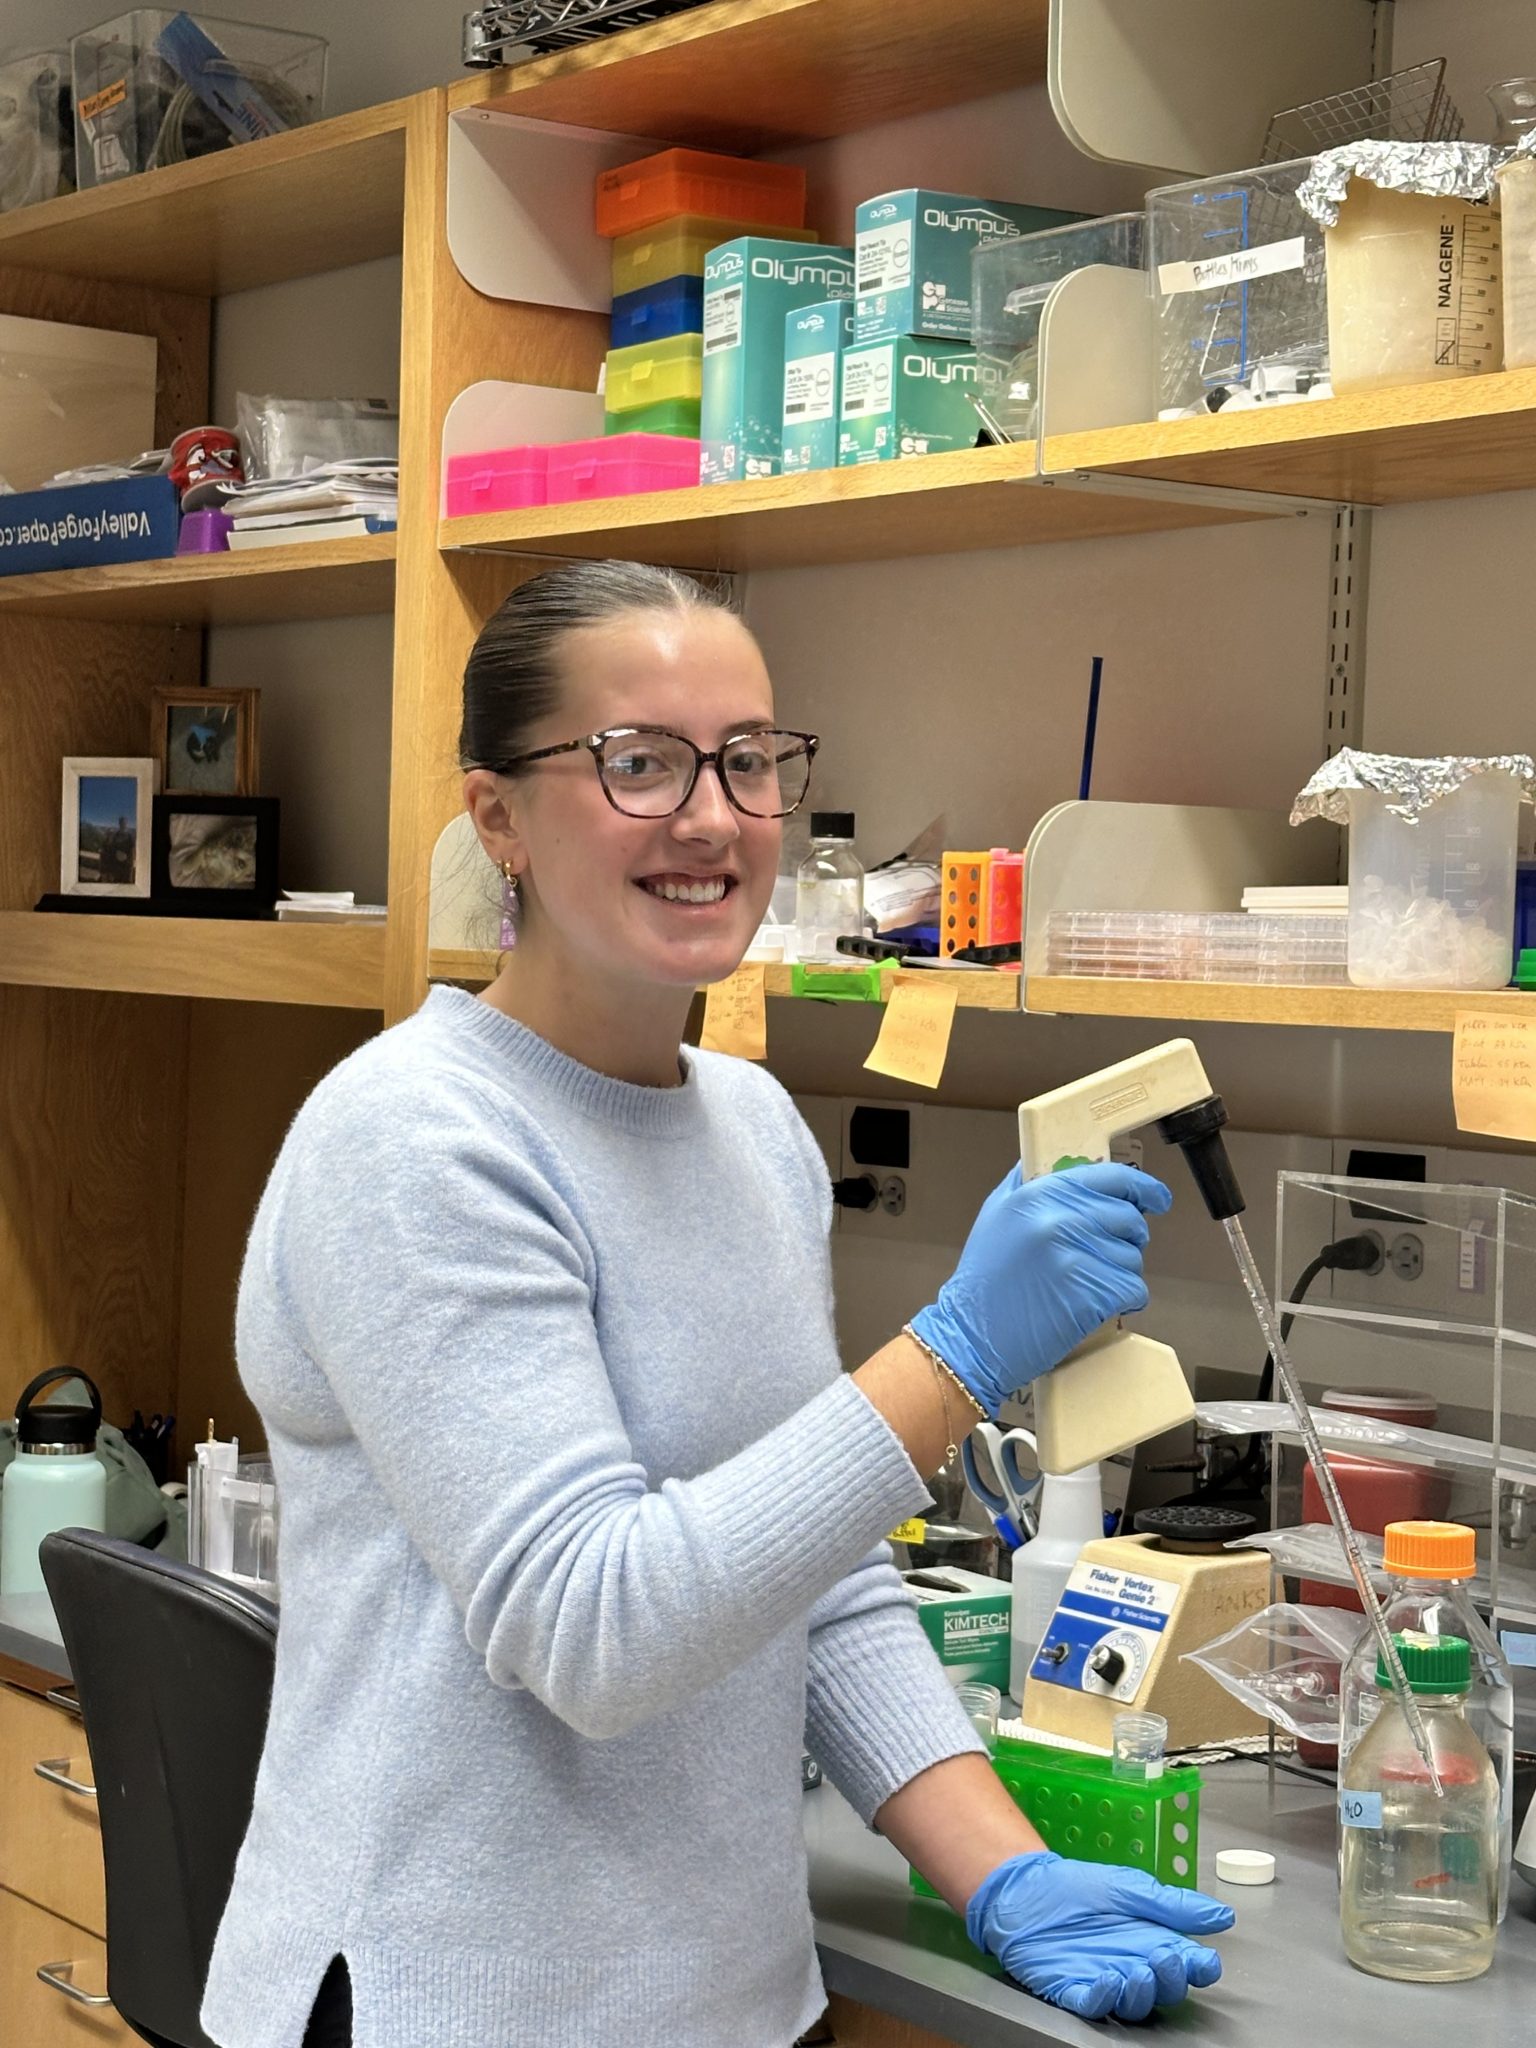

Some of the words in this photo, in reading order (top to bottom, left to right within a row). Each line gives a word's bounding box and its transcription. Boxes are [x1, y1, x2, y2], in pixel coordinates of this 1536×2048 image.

[923, 208, 1021, 237] Olympus
[1438, 224, 1455, 308] NALGENE
[0, 509, 151, 546] ValleyForgePaper.co
[1089, 1568, 1120, 1585] Fisher
[1124, 1576, 1155, 1593] Vortex
[1118, 1588, 1147, 1604] Genie
[1147, 1595, 1156, 1606] 2
[944, 1612, 1009, 1632] KIMTECH
